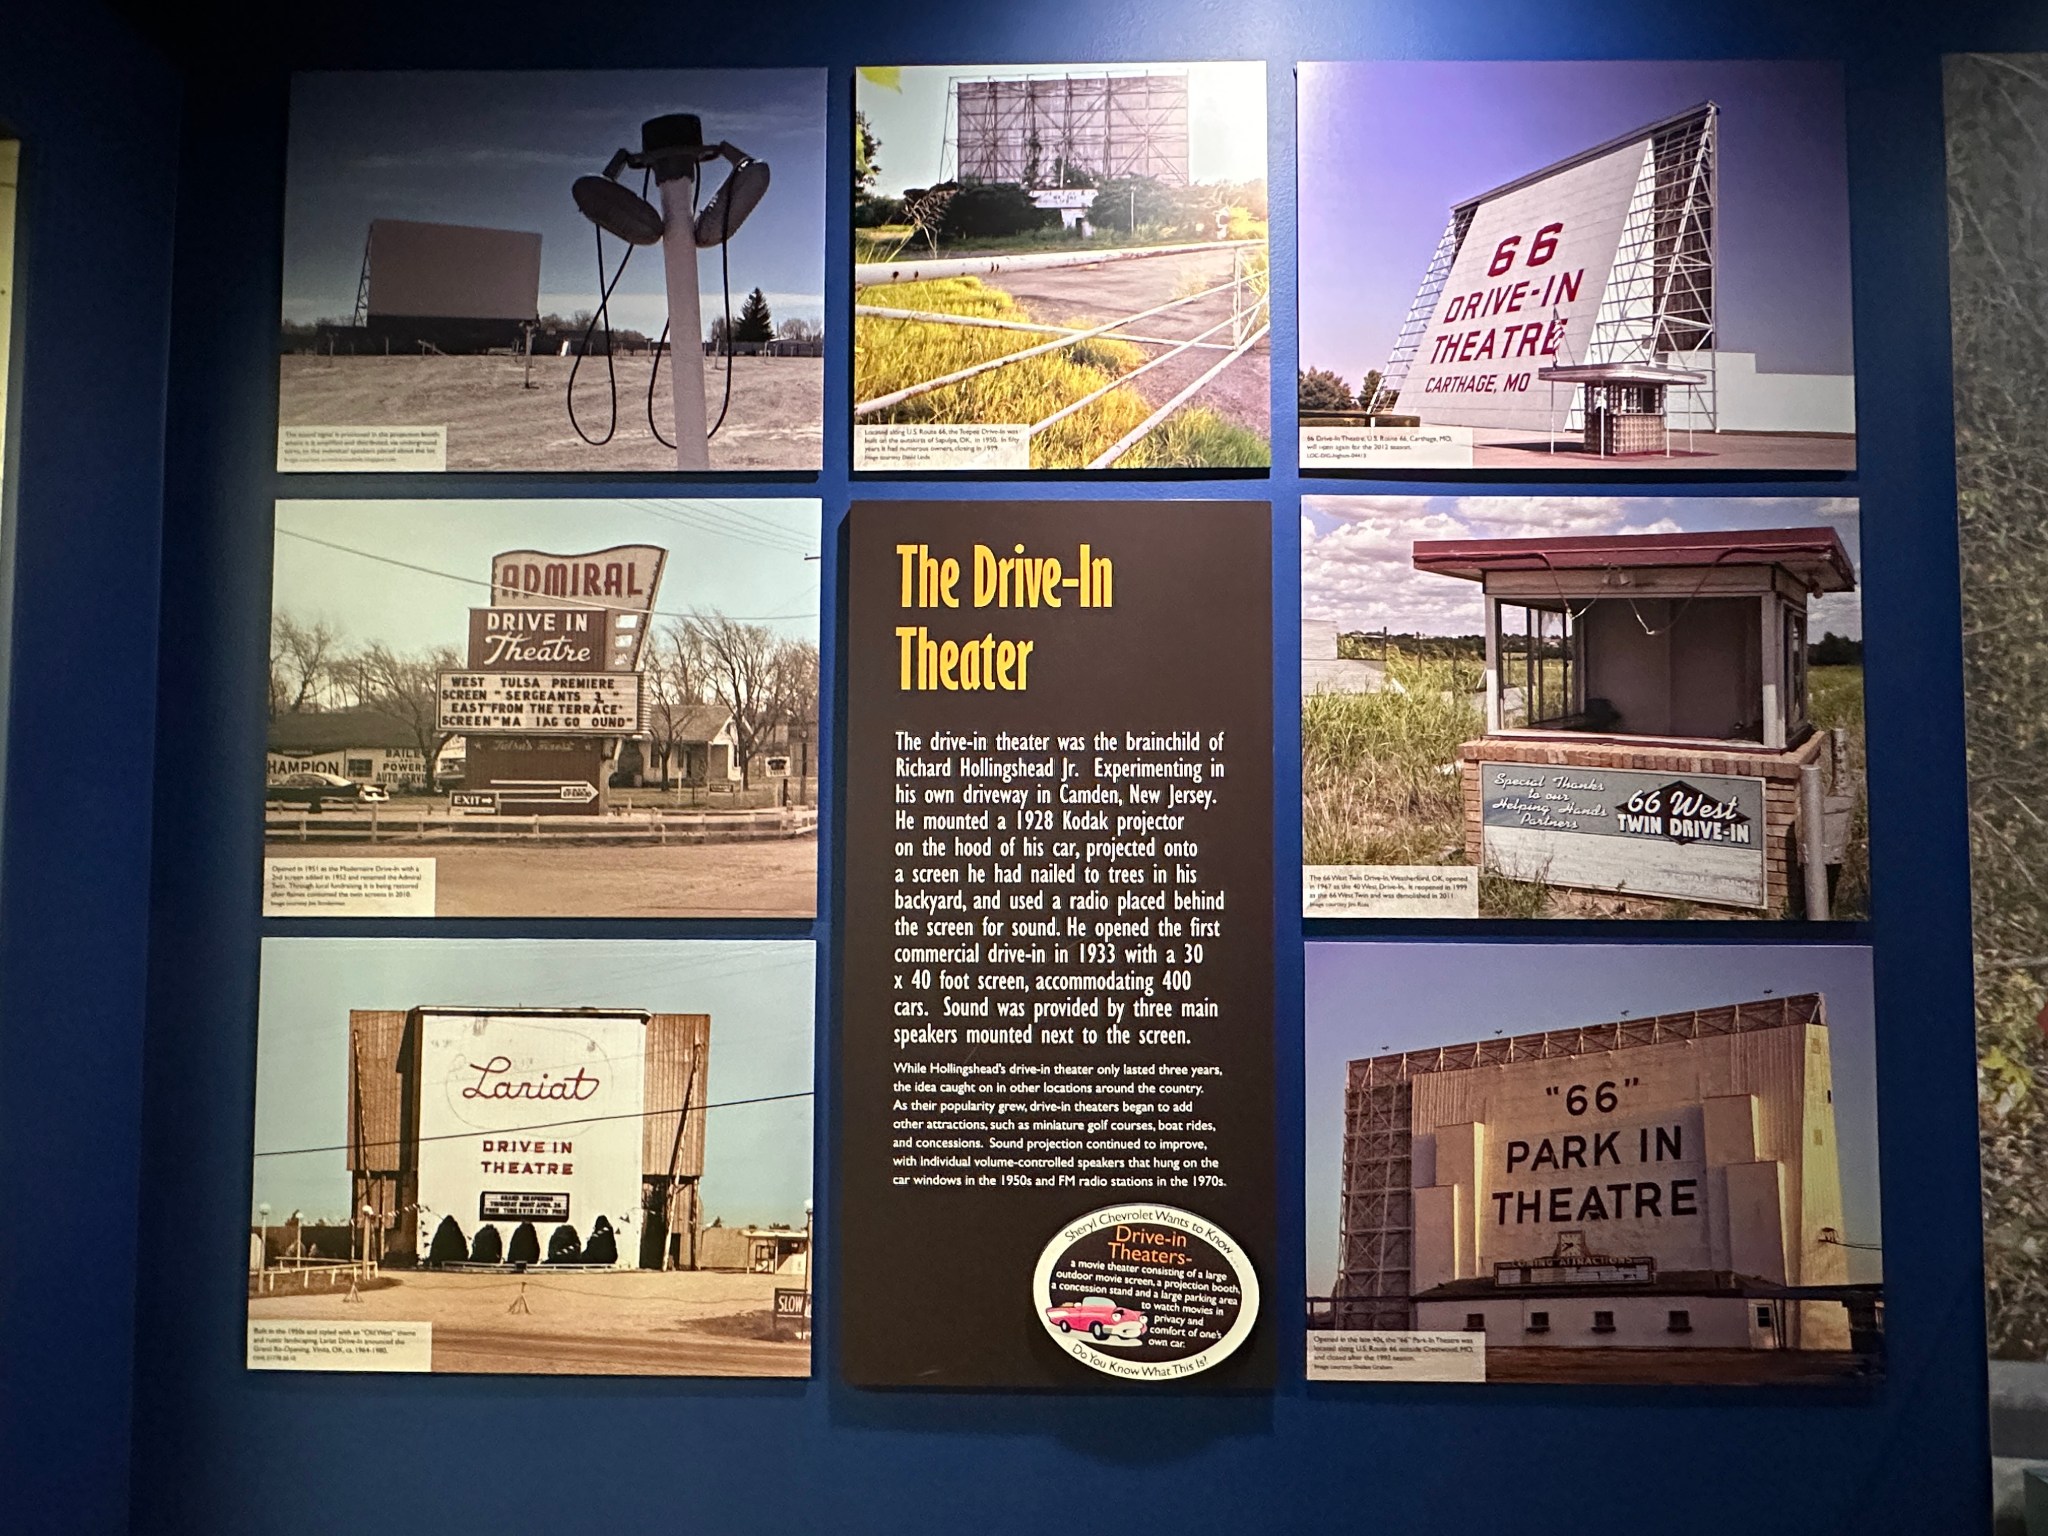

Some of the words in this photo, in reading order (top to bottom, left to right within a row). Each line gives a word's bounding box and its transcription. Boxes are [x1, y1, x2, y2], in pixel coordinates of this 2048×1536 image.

[1488, 222, 1563, 277] 66
[1443, 269, 1584, 324] DRIVE-IN
[1430, 318, 1568, 364] THEATRE
[1425, 374, 1497, 394] CARTHAGE,
[1504, 373, 1531, 392] MO
[501, 562, 643, 599] ADMIRAL
[896, 545, 960, 608] The
[974, 544, 1112, 608] Drive-In
[487, 612, 556, 631] DRIVE
[566, 613, 588, 632] IN
[484, 633, 591, 665] Theatre
[896, 627, 1033, 690] Theater
[451, 677, 485, 688] WEST
[500, 677, 540, 688] TULSA
[551, 678, 615, 689] PREMIERE
[442, 690, 487, 700] SCREEN
[530, 703, 553, 714] THE
[565, 717, 580, 727] GO
[896, 732, 921, 750] The
[930, 731, 986, 750] drive-in
[996, 732, 1050, 750] theater
[1057, 737, 1085, 750] was
[1094, 731, 1117, 750] the
[1126, 731, 1200, 751] brainchild
[1209, 732, 1224, 751] of
[385, 749, 425, 758] BAILE
[896, 757, 950, 777] Richard
[961, 757, 1055, 783] Hollingshead
[1061, 757, 1078, 782] Jr.
[1095, 757, 1202, 783] Experimenting
[1211, 758, 1224, 777] in
[1493, 772, 1544, 788] Special
[1552, 776, 1606, 792] Thanks
[454, 795, 481, 805] EXIT
[896, 784, 916, 803] his
[925, 789, 954, 803] own
[964, 784, 1028, 809] driveway
[1038, 784, 1050, 803] in
[1060, 784, 1122, 806] Camden,
[1130, 784, 1160, 803] New
[1168, 784, 1216, 810] Jersey.
[1528, 788, 1540, 800] to
[1545, 791, 1570, 802] our
[1627, 790, 1661, 814] 66
[1669, 790, 1738, 820] West
[1492, 798, 1550, 816] Helping
[1557, 802, 1608, 818] Hands
[896, 810, 914, 830] He
[924, 810, 988, 830] mounted
[998, 816, 1006, 830] a
[1018, 810, 1053, 830] 1928
[1063, 810, 1108, 830] Kodak
[1118, 810, 1184, 836] projector
[1520, 812, 1578, 830] Partners
[1616, 813, 1662, 835] TWIN
[1669, 817, 1750, 844] DRIVE-IN
[462, 1056, 600, 1100] Lariat
[894, 1062, 926, 1073] While
[930, 1062, 1006, 1077] Hollingshead's
[1009, 1064, 1050, 1074] drive-in
[1054, 1064, 1094, 1074] theater
[1097, 1064, 1120, 1077] only
[1124, 1064, 1155, 1074] lasted
[1159, 1064, 1188, 1074] three
[1191, 1067, 1222, 1078] years,
[1545, 1077, 1640, 1116] "66"
[483, 1140, 545, 1154] DRIVE
[553, 1141, 573, 1154] IN
[893, 1137, 912, 1148] and
[916, 1138, 983, 1148] concessions.
[990, 1137, 1023, 1148] Sound
[1027, 1138, 1082, 1152] projection
[1086, 1138, 1140, 1149] continued
[1144, 1141, 1156, 1149] to
[1160, 1139, 1207, 1152] improve,
[1506, 1130, 1621, 1174] PARK
[1640, 1125, 1682, 1162] IN
[480, 1161, 574, 1175] THEATRE
[913, 1174, 962, 1185] windows
[966, 1175, 975, 1185] in
[979, 1175, 996, 1185] the
[1002, 1175, 1032, 1186] 1950s
[1036, 1175, 1055, 1186] and
[1059, 1175, 1075, 1186] FM
[1079, 1176, 1107, 1186] radio
[1111, 1176, 1153, 1186] stations
[1157, 1176, 1166, 1186] in
[1170, 1176, 1188, 1186] the
[1194, 1176, 1226, 1186] 1970s.
[1492, 1179, 1698, 1225] THEATRE
[1064, 1218, 1097, 1242] Sheryl
[1099, 1209, 1153, 1225] Chevrolet
[1155, 1209, 1189, 1228] Wants
[1192, 1223, 1203, 1234] to
[1116, 1225, 1187, 1248] Drive-in
[1108, 1242, 1193, 1265] Theaters-
[1056, 1270, 1093, 1281] outdoor
[1095, 1274, 1122, 1283] movie
[1164, 1279, 1209, 1292] projection
[1212, 1283, 1241, 1294] booth,
[1078, 1260, 1106, 1270] movie
[1107, 1262, 1140, 1273] theater
[1142, 1266, 1184, 1279] consisting
[1187, 1268, 1198, 1278] of
[1205, 1270, 1227, 1282] large
[778, 1296, 804, 1312] SLOW
[1072, 1343, 1088, 1360] Do
[1089, 1353, 1107, 1369] You
[1109, 1360, 1140, 1376] Know
[1141, 1367, 1171, 1377] What
[1172, 1362, 1194, 1375] This
[1195, 1355, 1208, 1368] Is?
